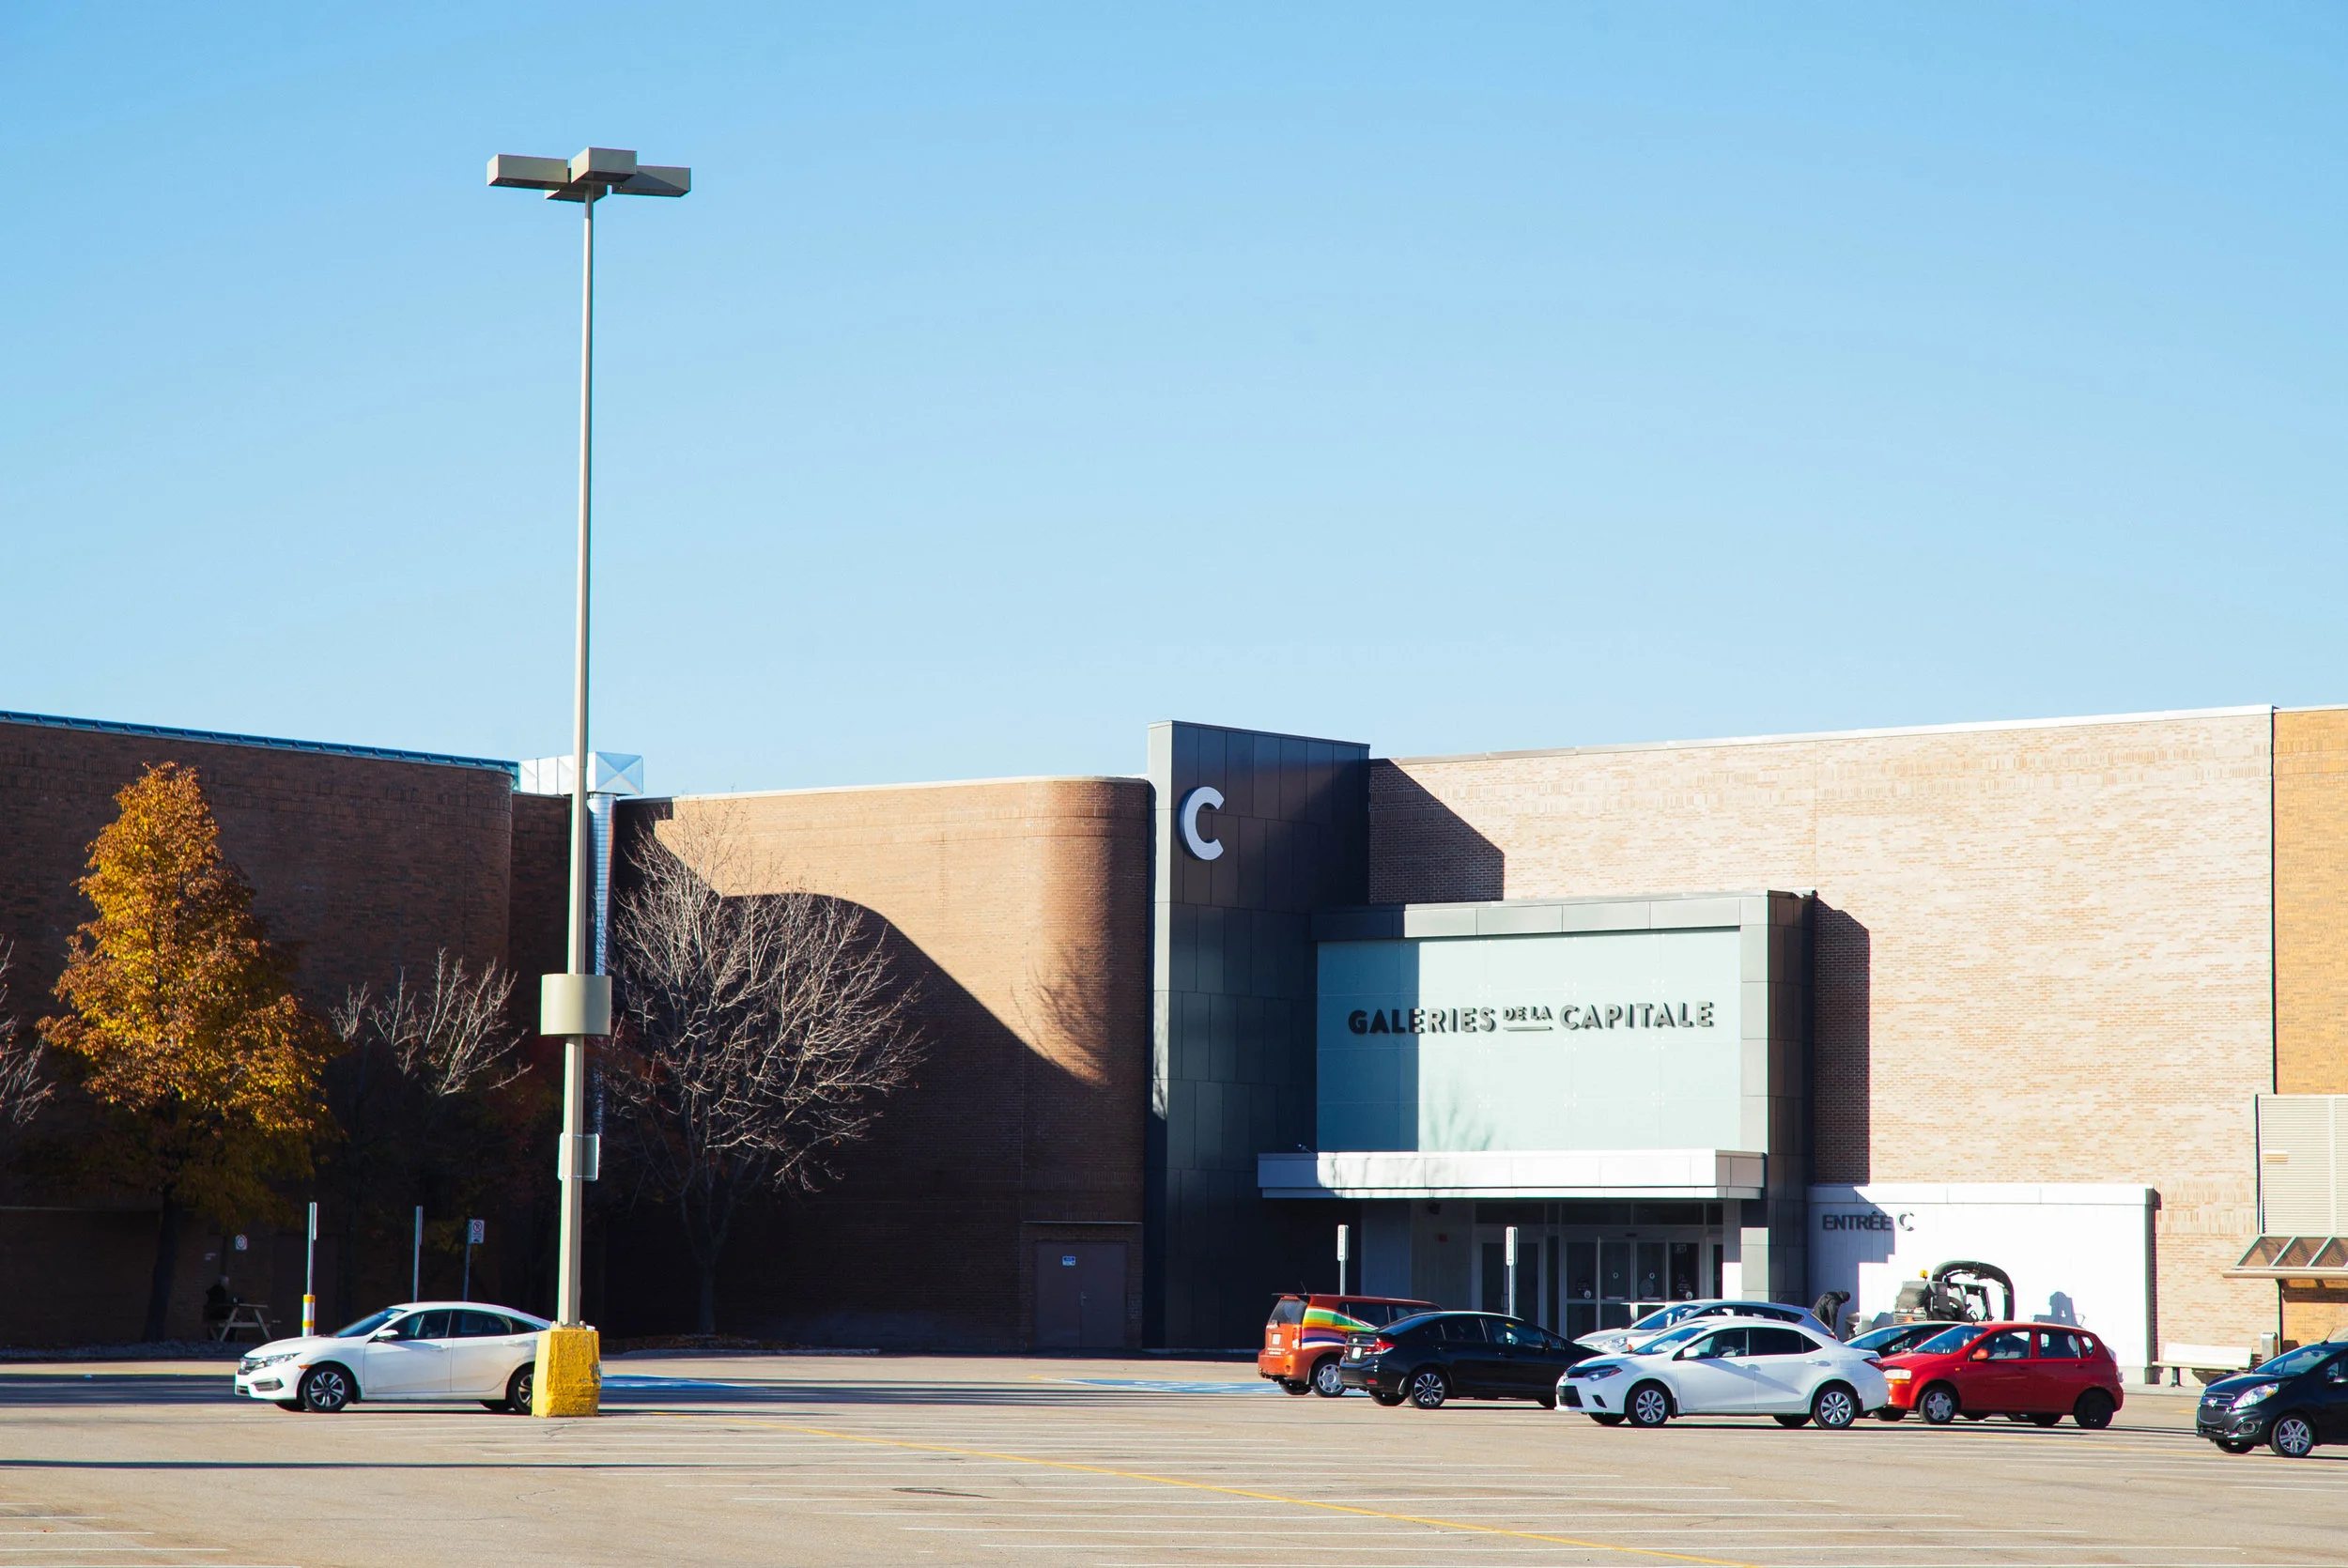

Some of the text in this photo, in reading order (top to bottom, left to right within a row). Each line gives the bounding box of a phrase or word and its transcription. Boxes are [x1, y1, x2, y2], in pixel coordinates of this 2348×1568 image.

[1180, 786, 1225, 861] C
[1348, 1001, 1714, 1034] GALERIES DE LA CAPITALE
[1823, 1211, 1915, 1232] ENTRÉE C
